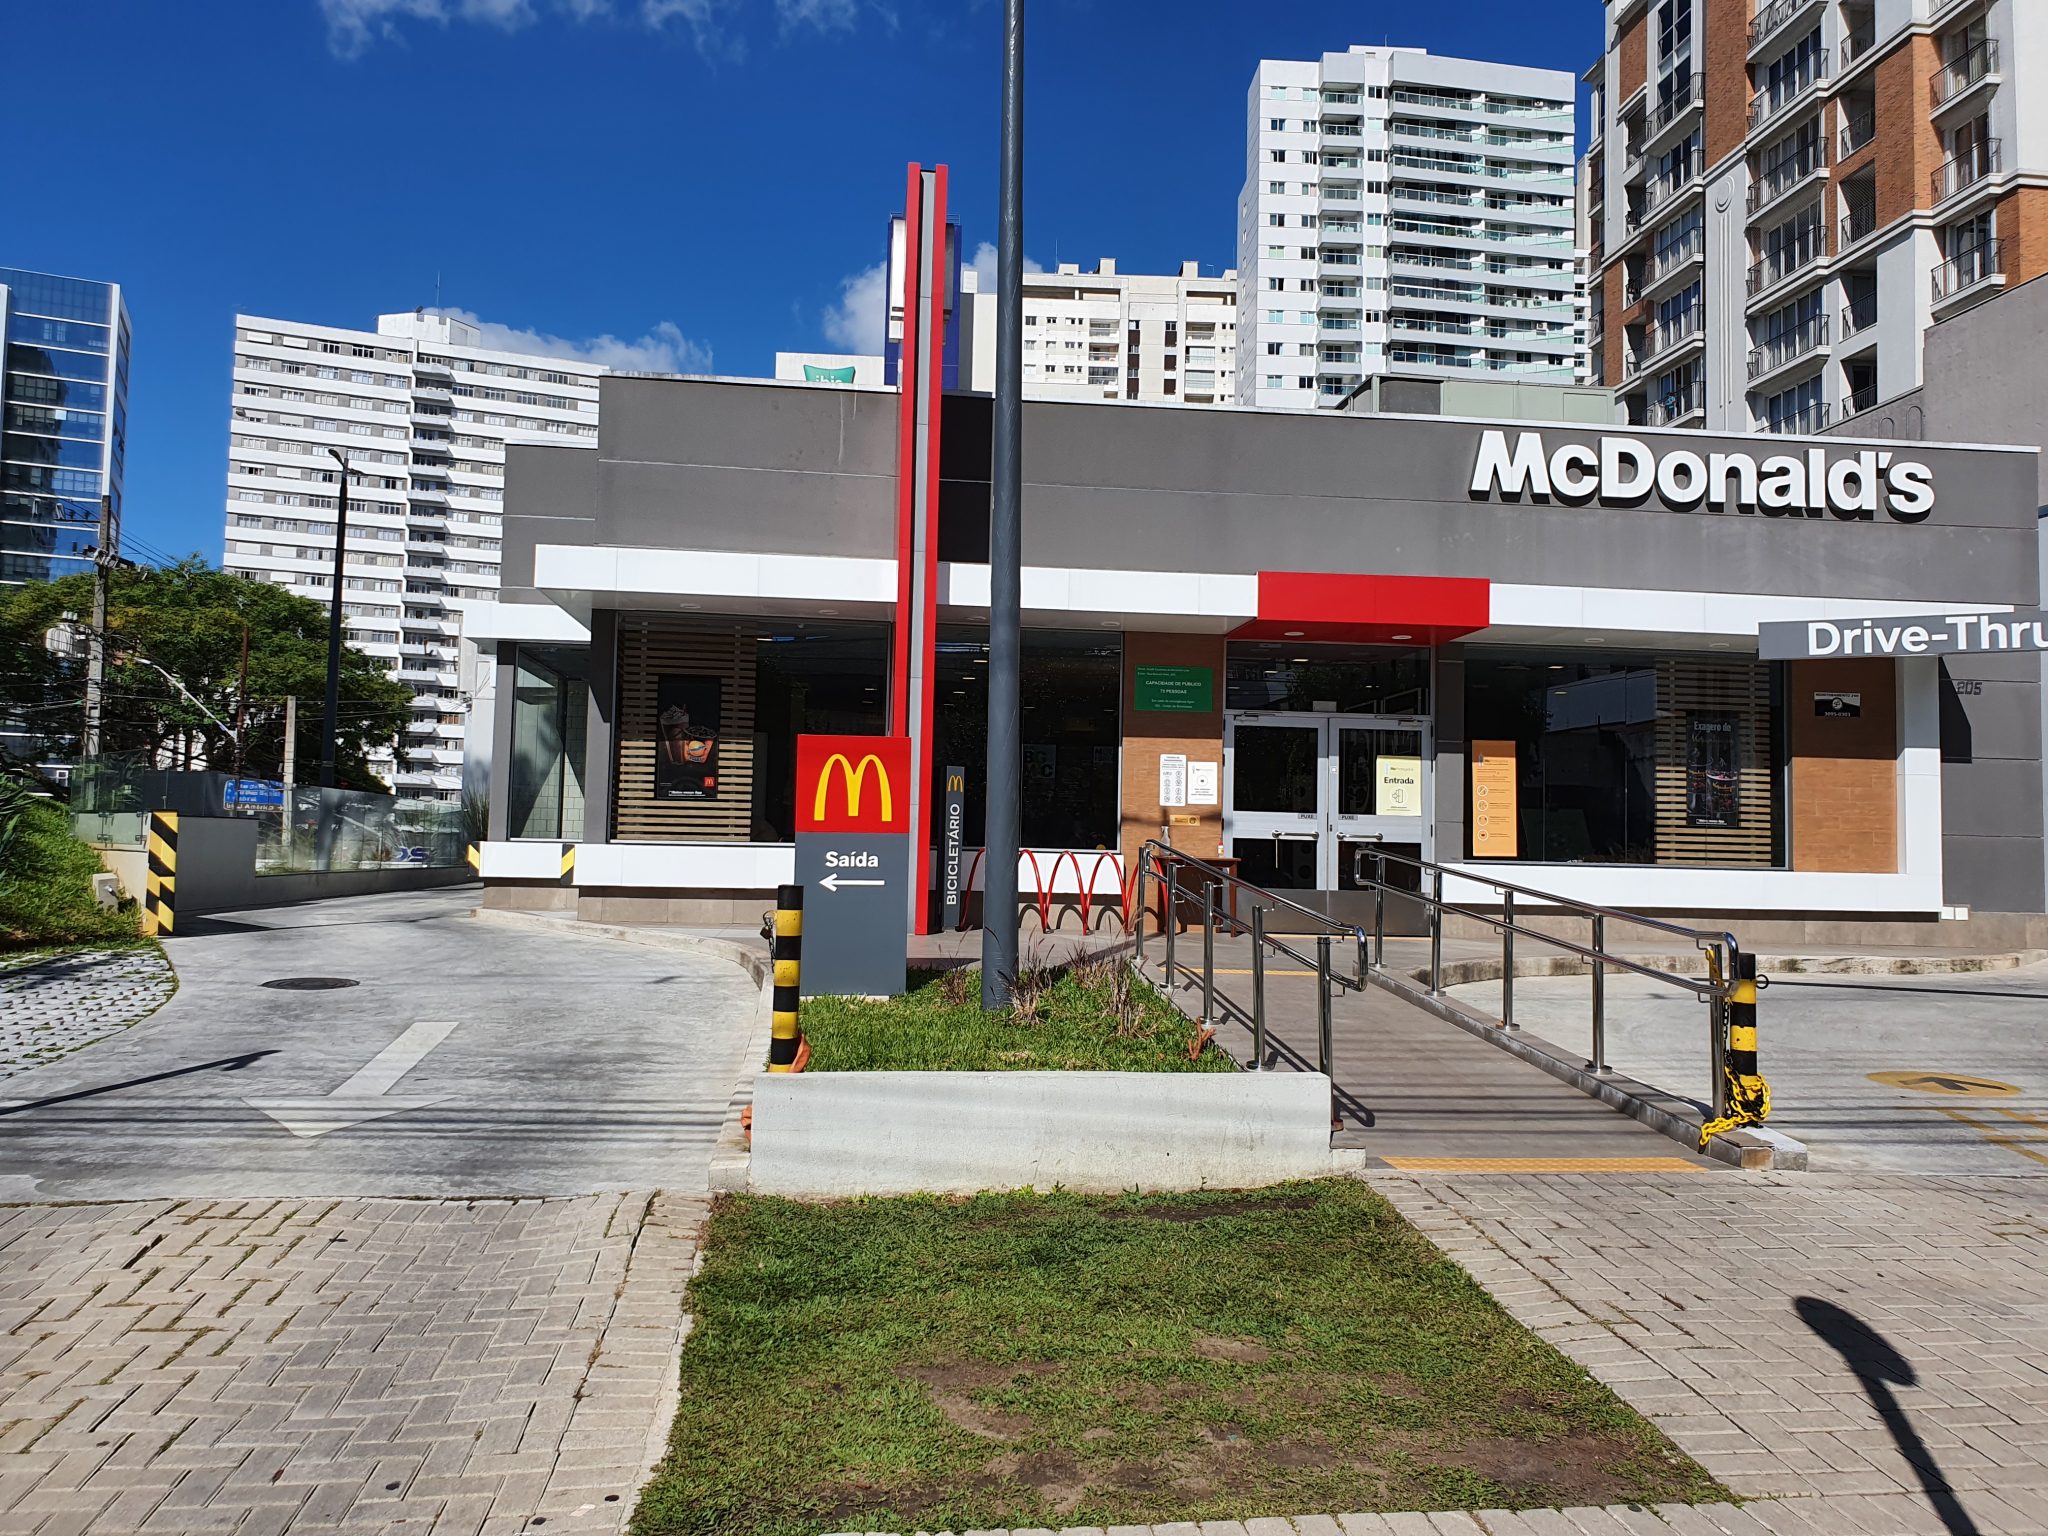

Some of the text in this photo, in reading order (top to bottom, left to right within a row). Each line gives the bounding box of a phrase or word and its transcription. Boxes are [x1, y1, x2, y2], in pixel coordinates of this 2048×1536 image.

[1469, 430, 1936, 516] McDonald's
[1957, 681, 1983, 695] 205
[1383, 776, 1415, 785] Entrada
[825, 850, 879, 868] Saída
[946, 803, 961, 905] BICICLETÁRIO
